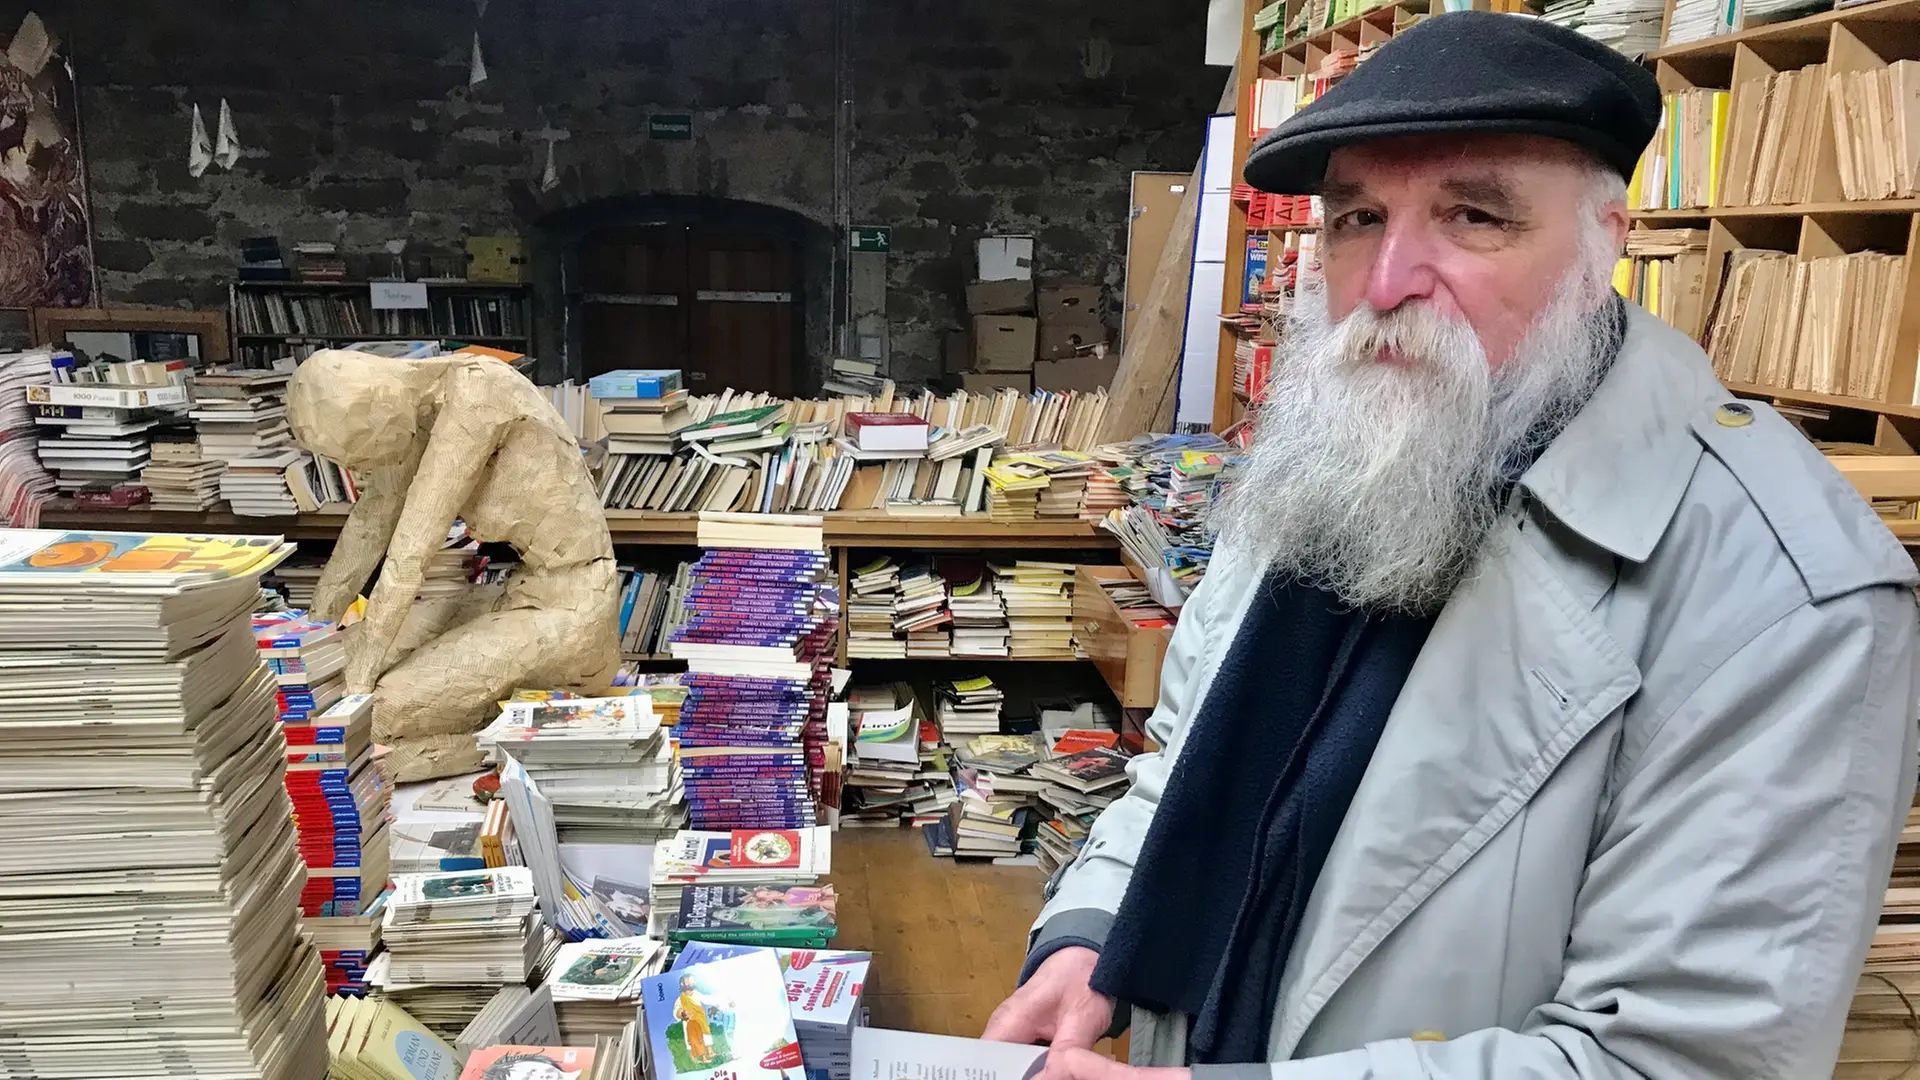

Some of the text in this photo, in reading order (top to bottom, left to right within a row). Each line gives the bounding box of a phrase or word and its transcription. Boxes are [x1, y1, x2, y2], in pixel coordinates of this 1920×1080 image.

[862, 718, 906, 729] Linux
[403, 1034, 421, 1065] ROMAN
[416, 1048, 430, 1069] UND
